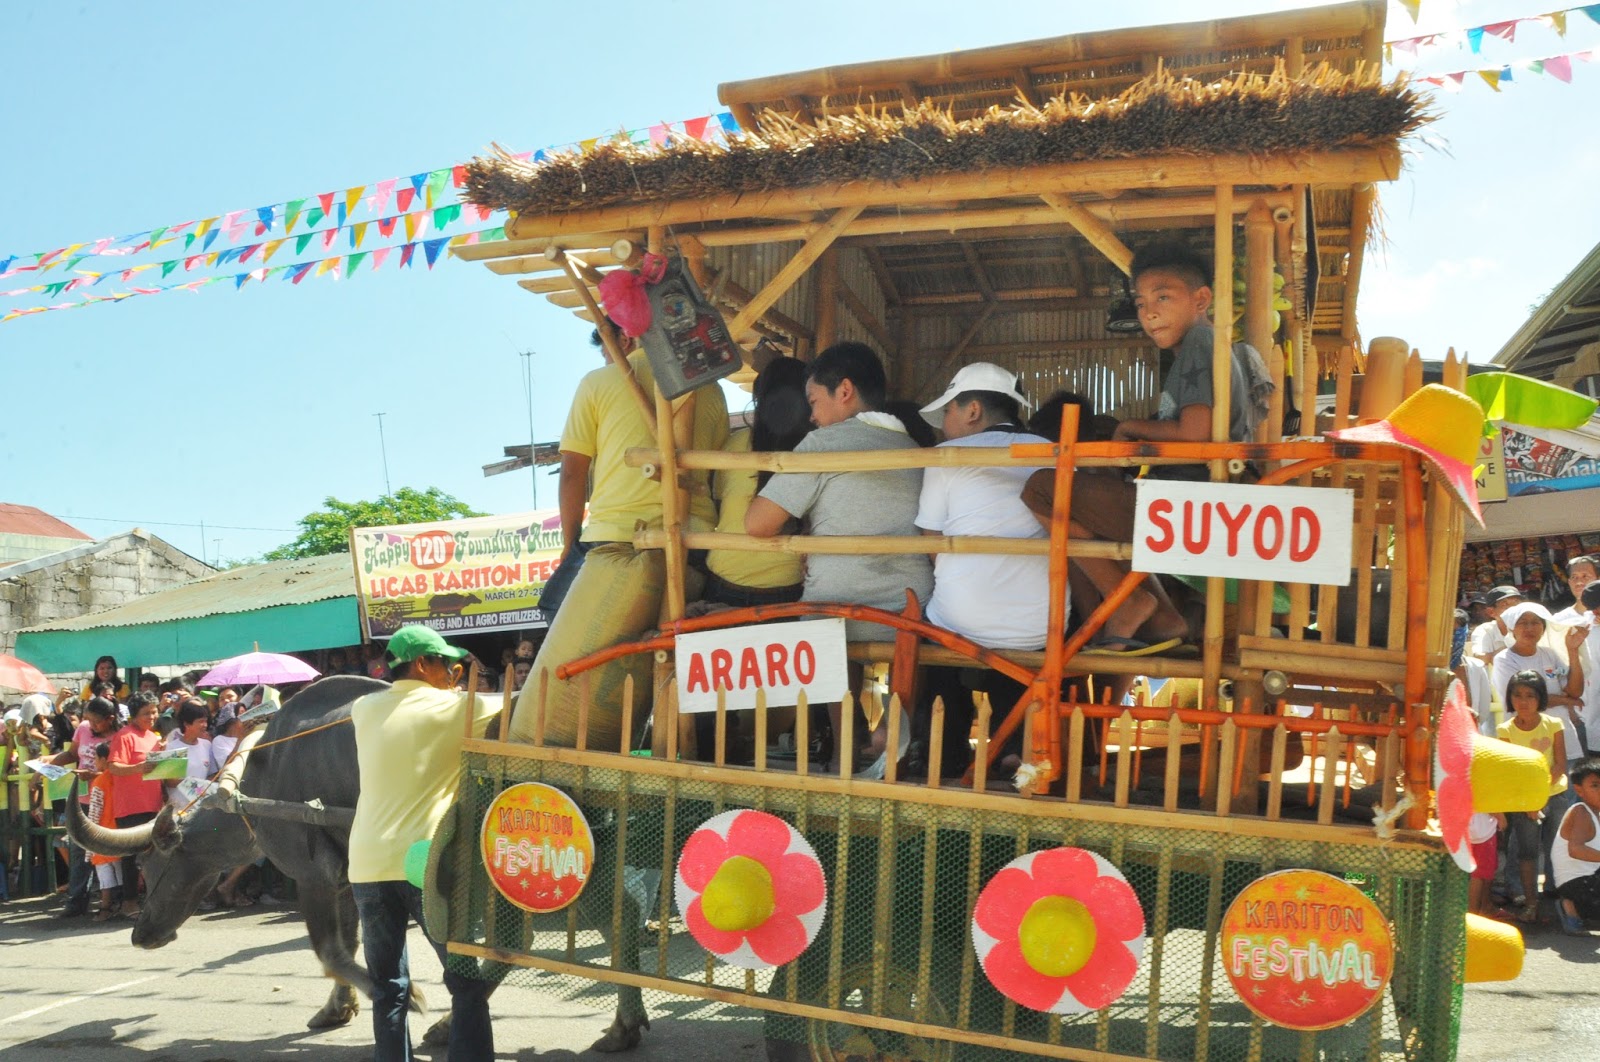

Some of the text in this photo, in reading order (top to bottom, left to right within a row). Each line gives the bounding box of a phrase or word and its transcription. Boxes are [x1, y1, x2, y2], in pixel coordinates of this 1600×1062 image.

[1145, 498, 1321, 563] SUYOD
[364, 541, 410, 574] Happy
[454, 529, 522, 562] Founding
[370, 573, 428, 599] LICAB
[432, 563, 521, 593] KARITON
[484, 591, 516, 601] MARCH
[446, 616, 462, 630] AND
[475, 613, 498, 627] AGRO
[499, 609, 541, 625] FERTILIZERS
[687, 640, 816, 693] ARARO
[499, 807, 573, 836] KARITON
[494, 836, 587, 881] FESTIVAL
[1244, 900, 1364, 932] KARITON
[1231, 936, 1382, 990] FESTIVAL
